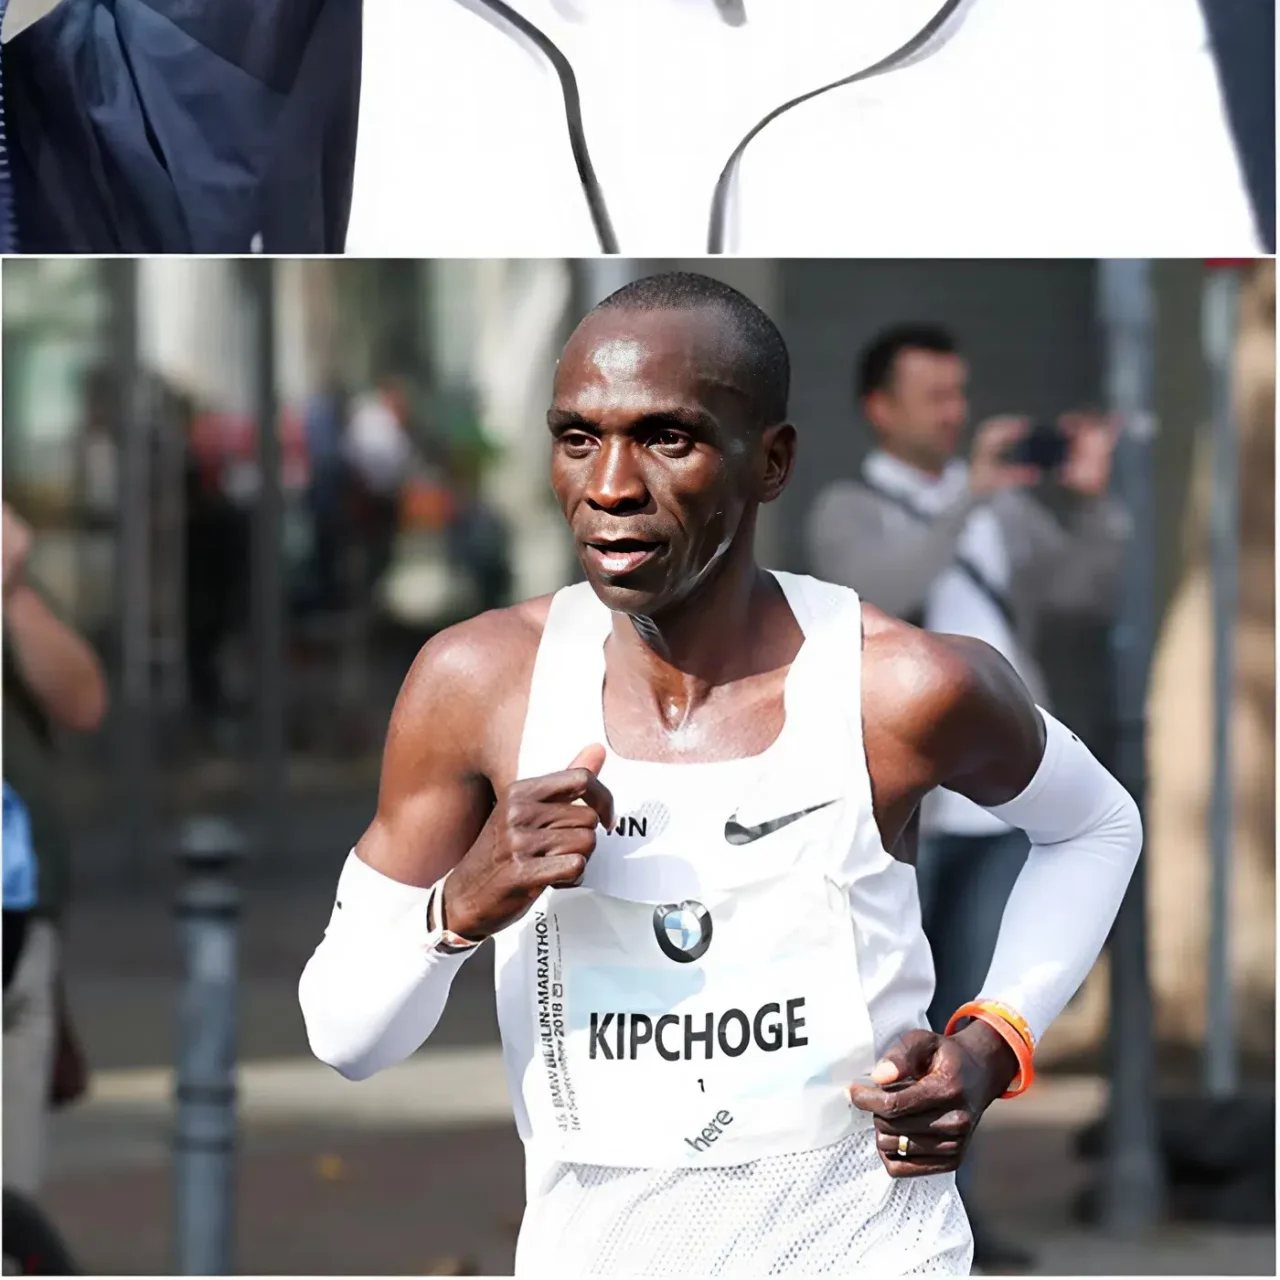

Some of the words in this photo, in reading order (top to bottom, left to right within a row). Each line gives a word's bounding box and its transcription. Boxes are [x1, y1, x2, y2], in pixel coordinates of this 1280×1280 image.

[552, 1003, 565, 1038] 2018
[588, 997, 808, 1061] KIPCHOGE
[684, 1109, 734, 1152] here
